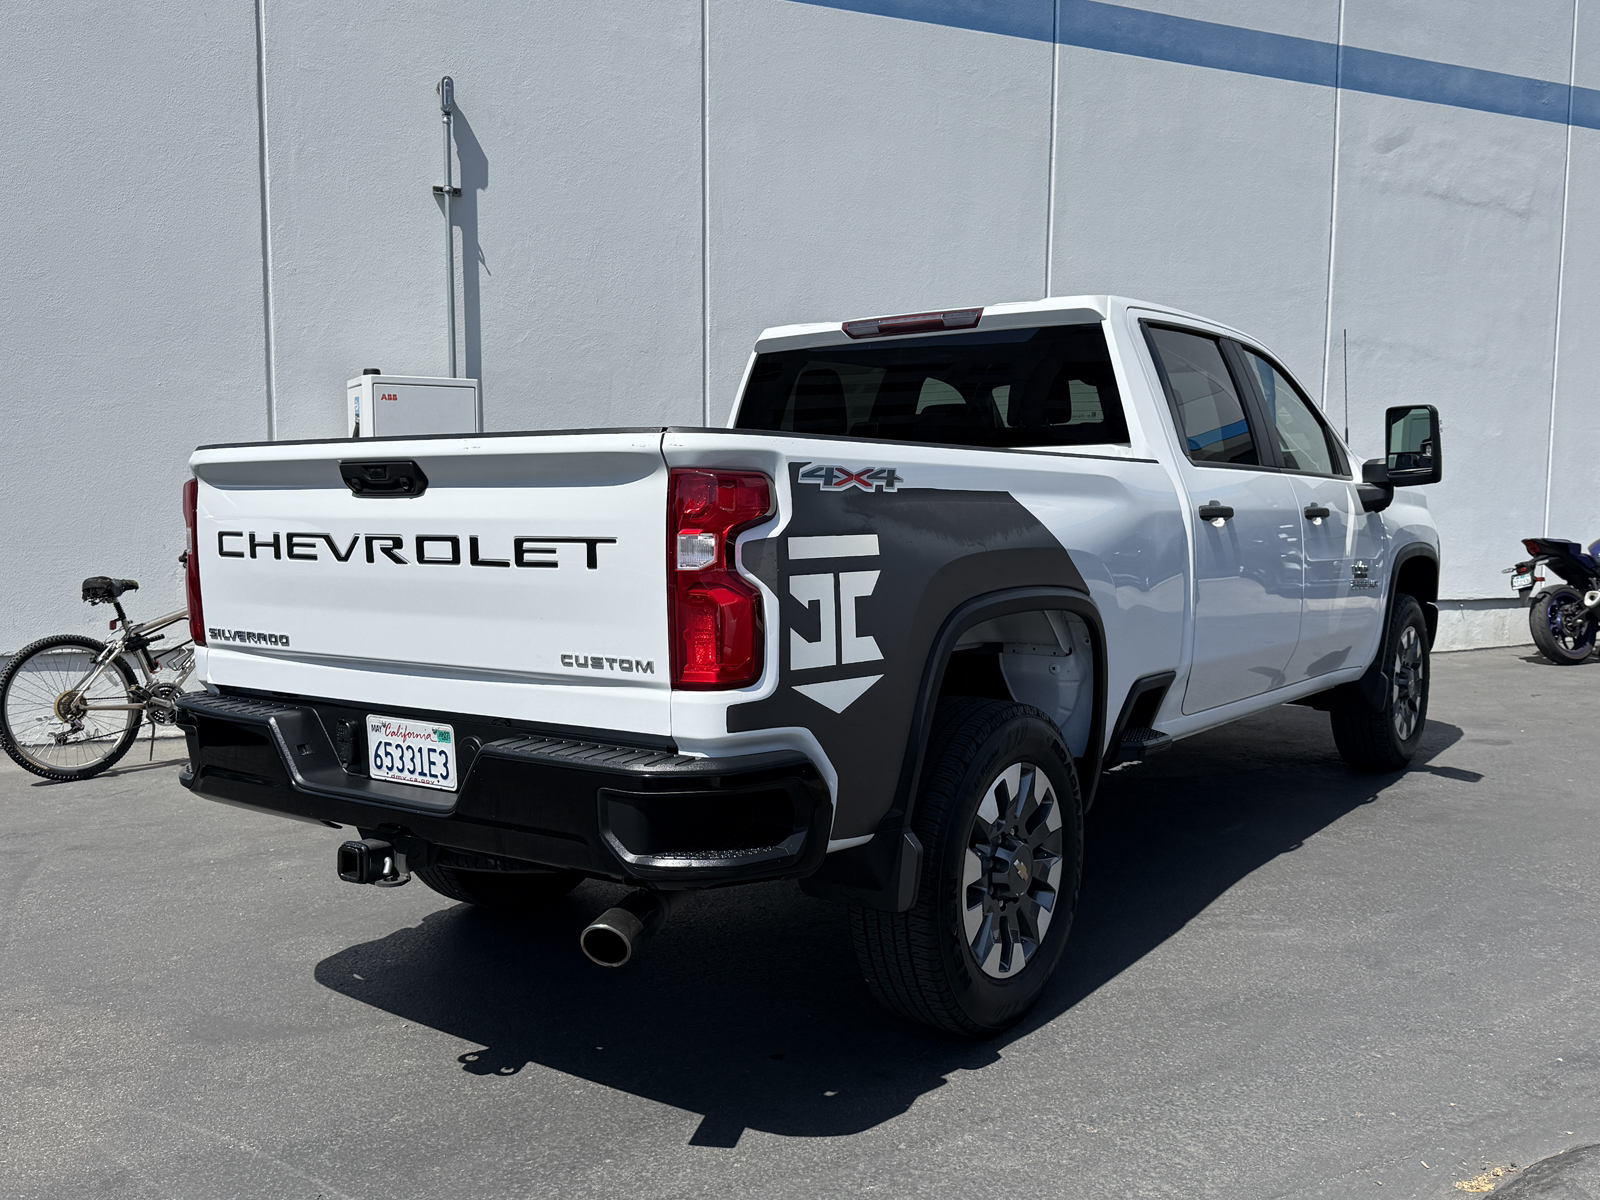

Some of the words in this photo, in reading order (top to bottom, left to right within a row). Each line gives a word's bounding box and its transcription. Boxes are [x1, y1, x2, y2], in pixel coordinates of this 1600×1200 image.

[381, 393, 398, 401] ABB
[218, 531, 618, 570] CHEVROLET
[209, 627, 290, 647] SILVERADO
[561, 653, 655, 675] CUSTOM
[371, 723, 383, 733] MAY
[385, 722, 437, 743] California
[374, 741, 449, 780] 65331E3
[391, 774, 435, 785] dmv.ca.gov
